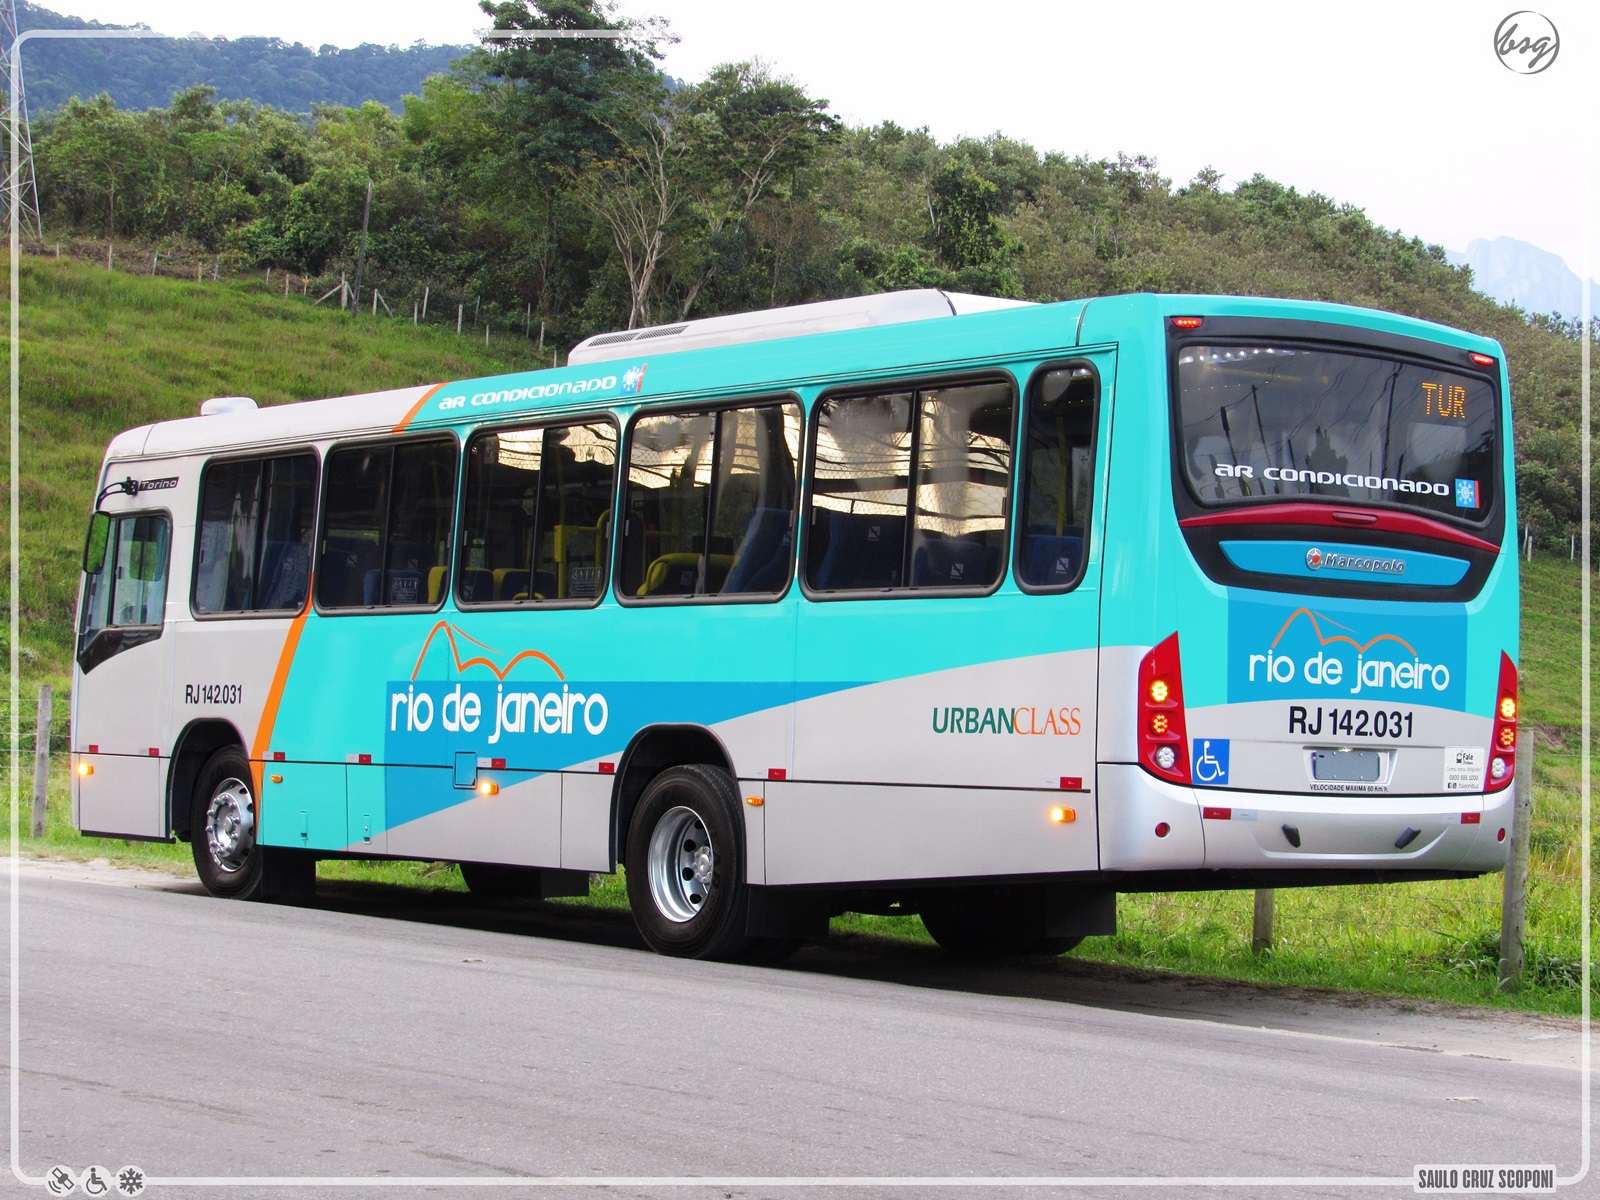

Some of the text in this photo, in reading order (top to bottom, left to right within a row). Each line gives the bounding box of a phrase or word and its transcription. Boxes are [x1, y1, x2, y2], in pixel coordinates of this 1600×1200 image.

[1422, 382, 1467, 419] TUR
[141, 479, 177, 490] Torino
[1324, 553, 1405, 573] Marcopolo
[1249, 649, 1450, 694] rio de janeiro
[185, 684, 243, 704] RJ 142.031
[390, 684, 609, 743] rio de janeiro
[1288, 706, 1414, 738] RJ 142.031
